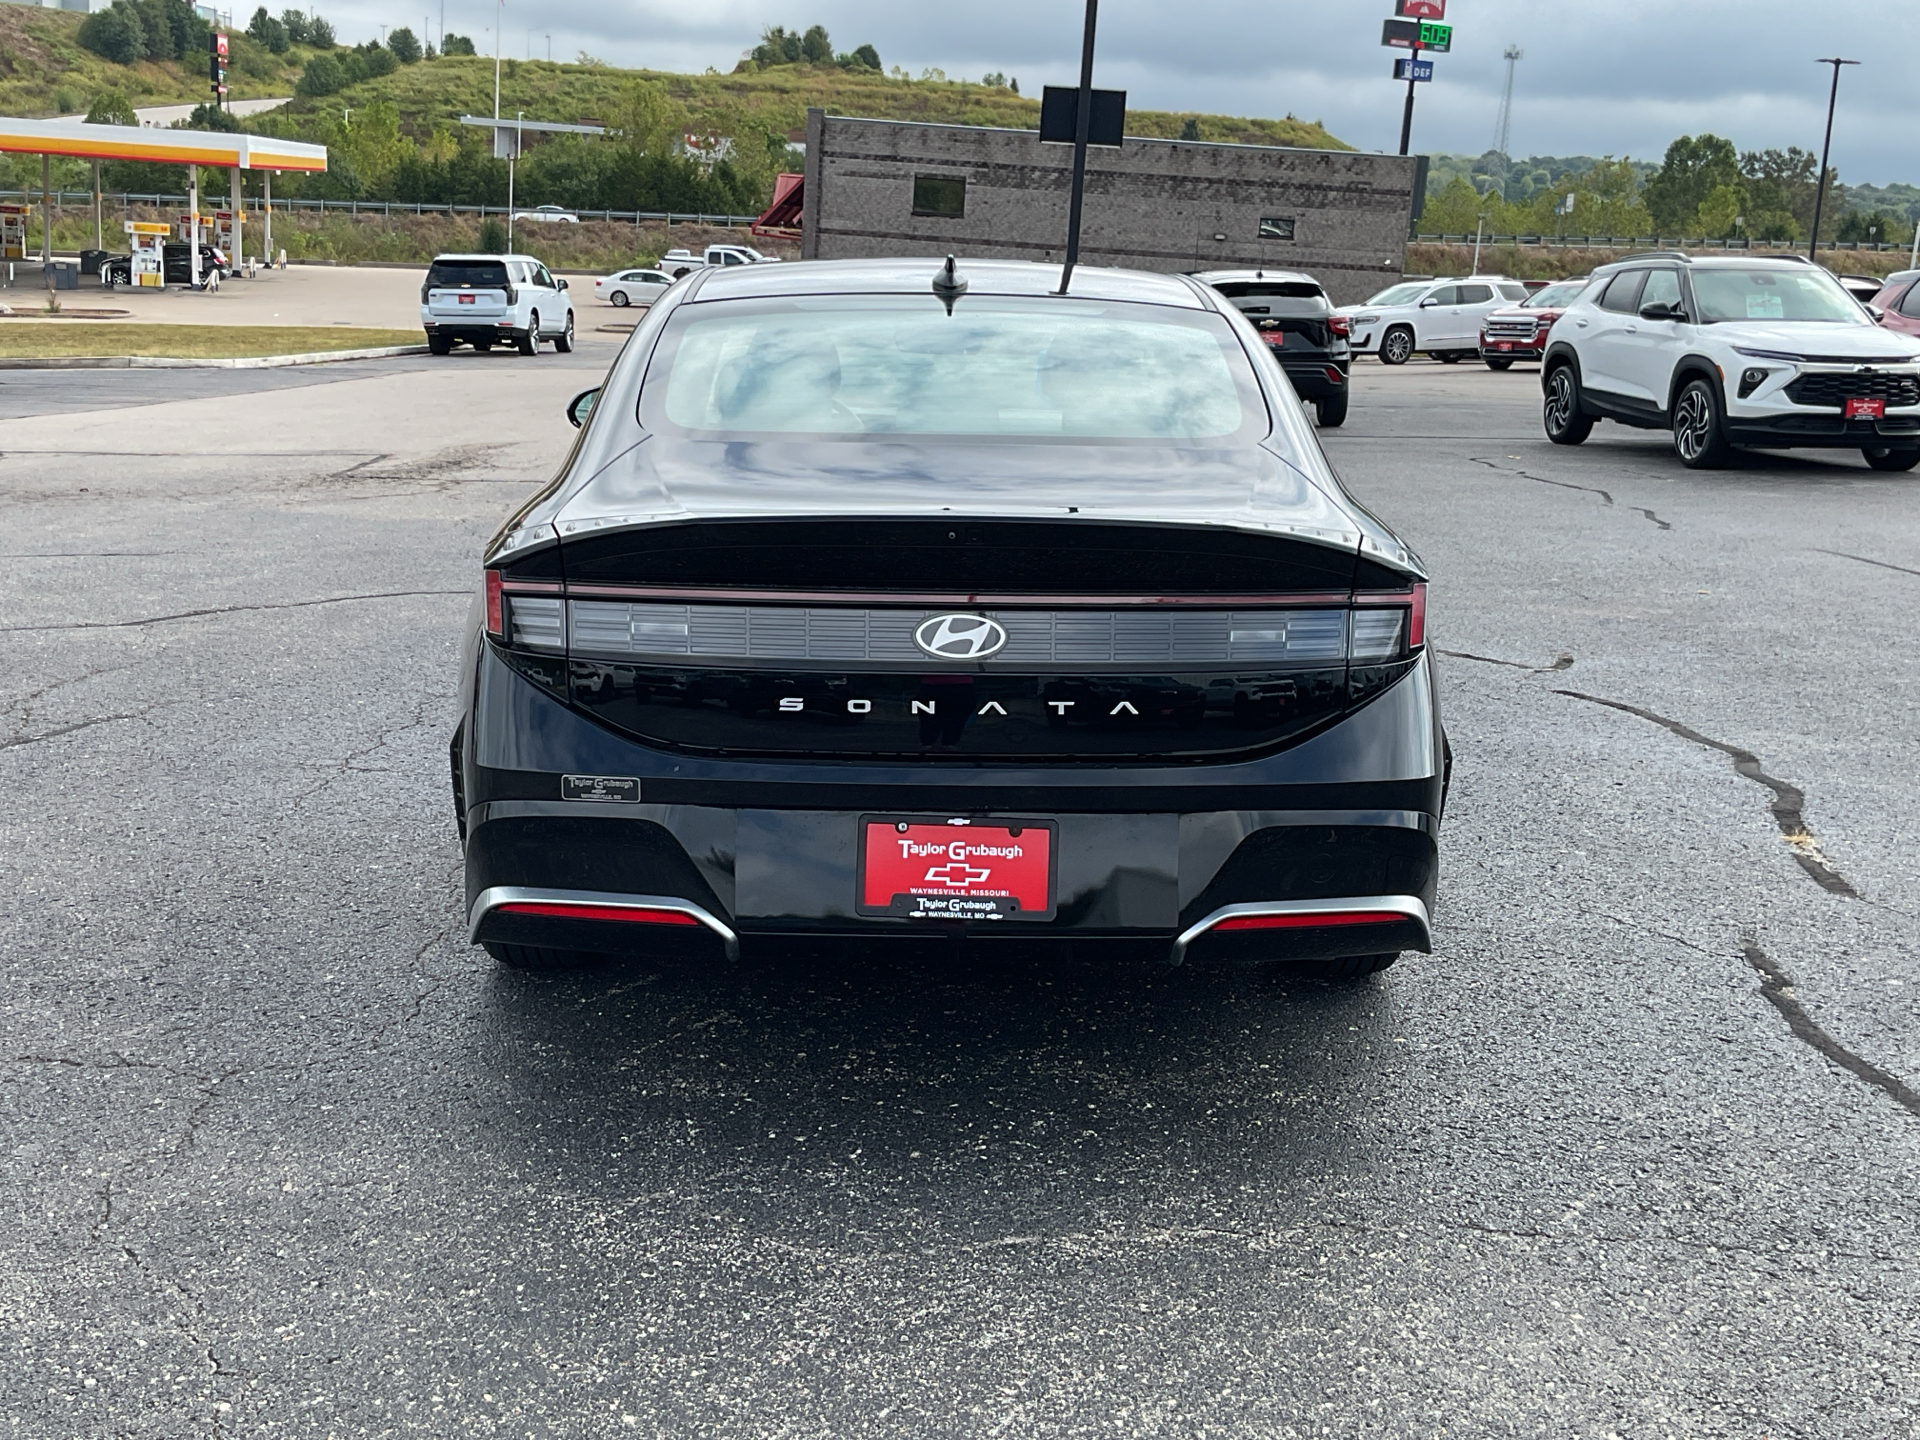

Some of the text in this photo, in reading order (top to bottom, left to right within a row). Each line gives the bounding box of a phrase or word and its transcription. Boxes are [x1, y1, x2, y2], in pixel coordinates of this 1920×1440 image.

[1413, 67, 1431, 78] DEF
[779, 697, 1139, 716] SONATA
[568, 777, 633, 790] Taylor Grubaugh
[897, 839, 1023, 861] Taylor Grubaugh
[909, 887, 1009, 897] WAYNESVILLE, MISSOURI
[916, 897, 996, 912] Taylor Grubaugh
[927, 911, 973, 919] WAYNESVILLE,
